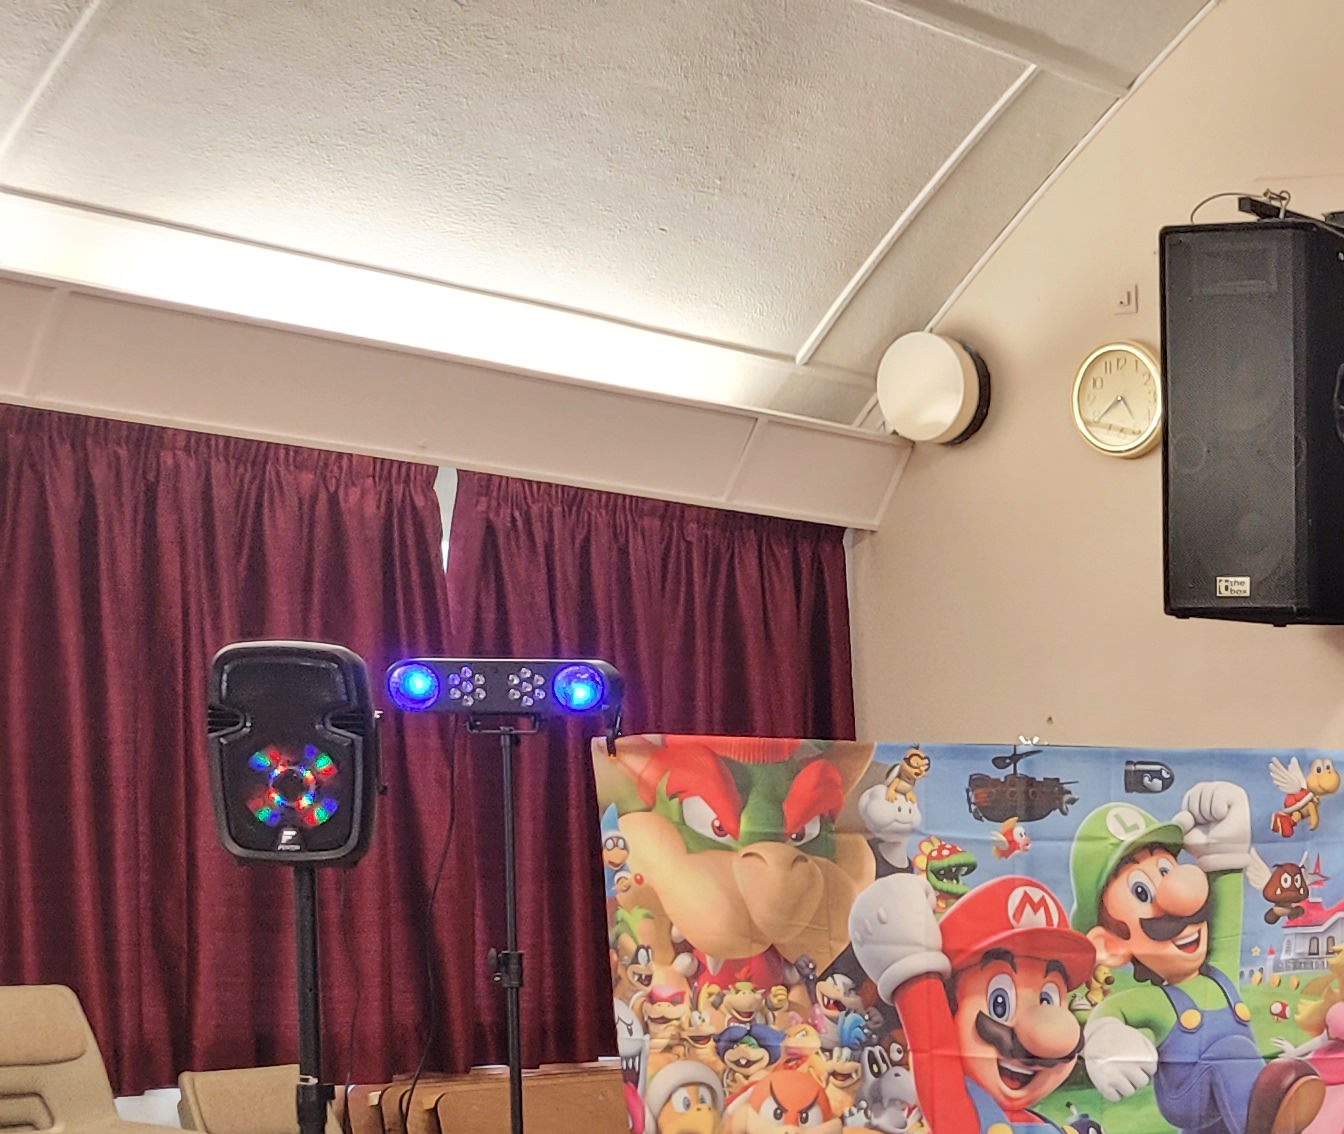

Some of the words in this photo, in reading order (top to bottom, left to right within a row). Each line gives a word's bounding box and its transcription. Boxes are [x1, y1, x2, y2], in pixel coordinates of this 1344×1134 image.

[1104, 360, 1112, 375] 11
[1116, 357, 1127, 370] 12
[1092, 376, 1104, 390] 10
[1114, 814, 1140, 833] L
[1012, 890, 1055, 929] M
